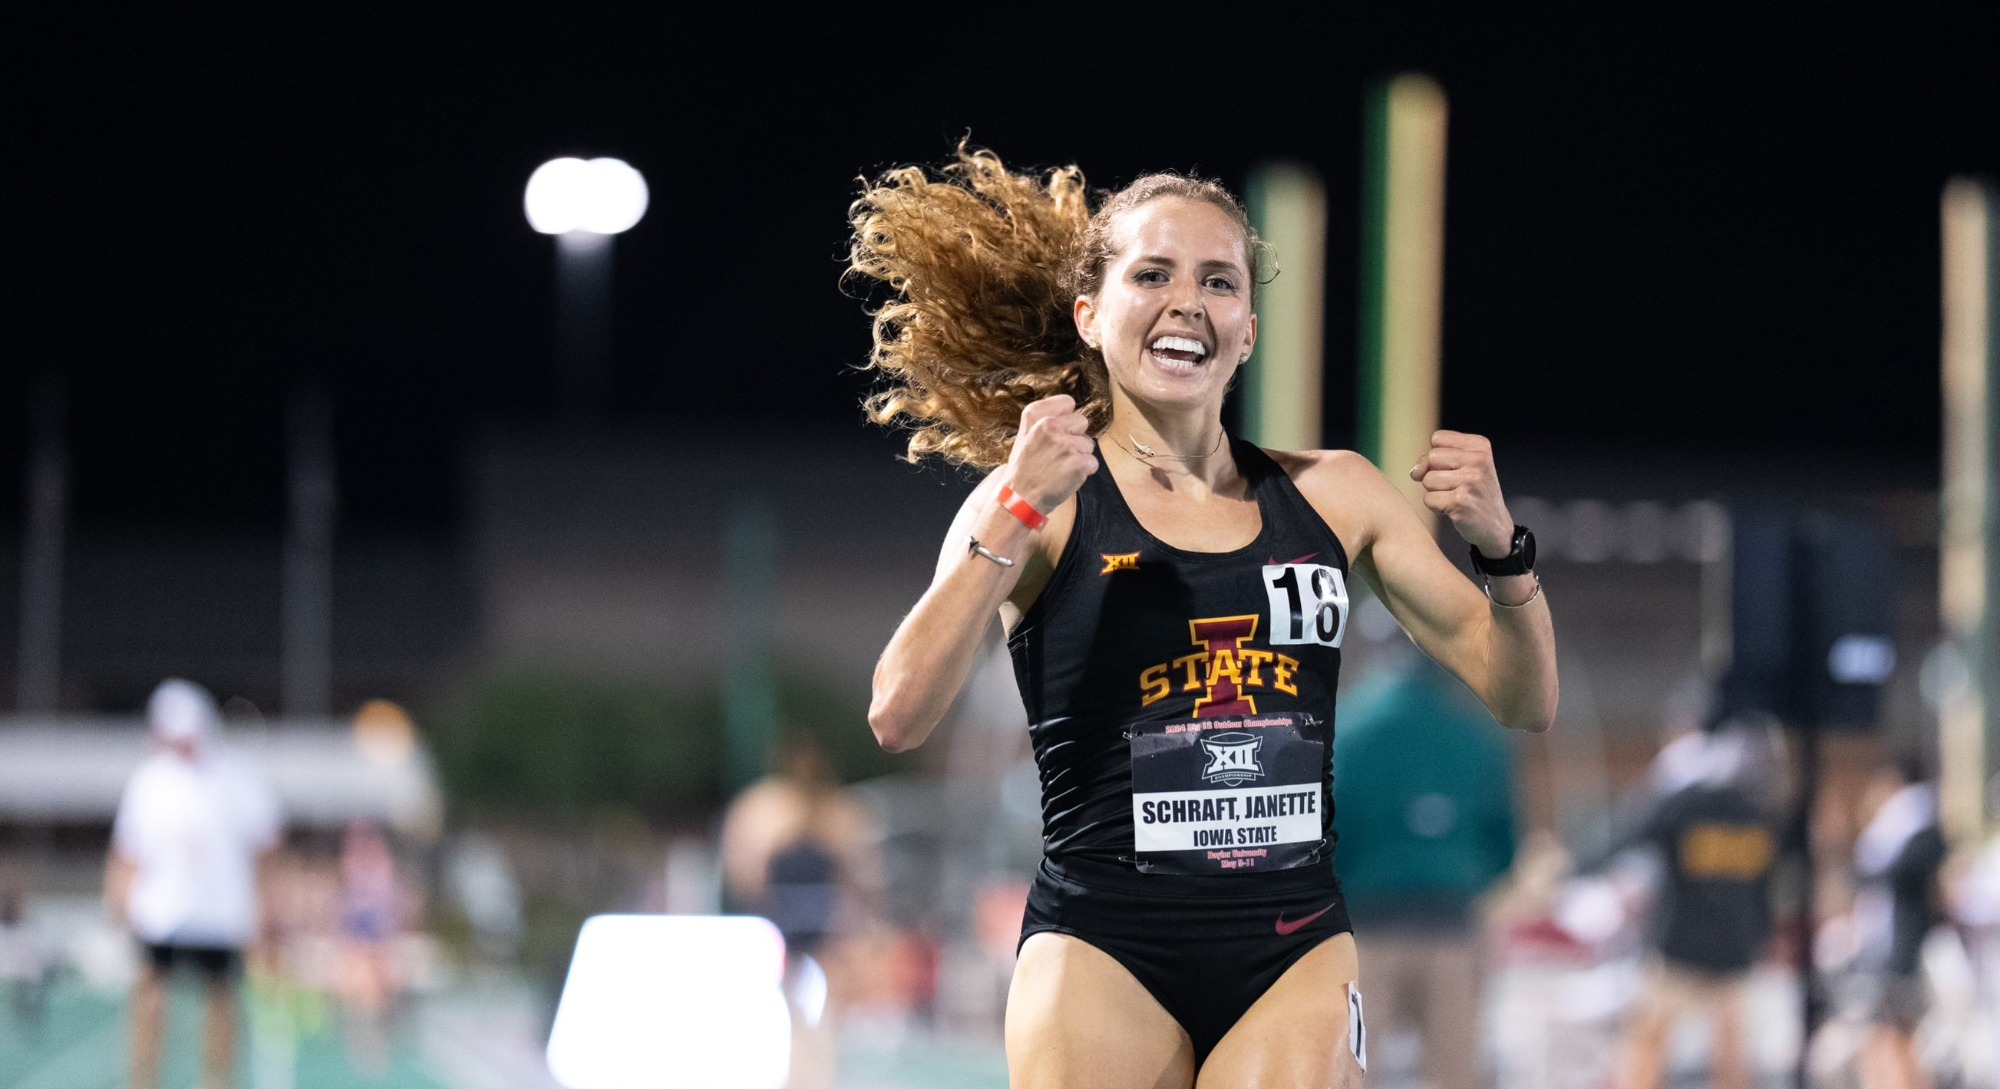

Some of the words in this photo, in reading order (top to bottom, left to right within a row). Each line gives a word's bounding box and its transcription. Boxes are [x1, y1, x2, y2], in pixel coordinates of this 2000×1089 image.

[1100, 551, 1142, 576] XII
[1140, 649, 1299, 707] STATE
[1165, 724, 1186, 734] 2024
[1187, 723, 1201, 733] Big
[1202, 721, 1212, 730] 12
[1213, 719, 1242, 729] Outdoor
[1243, 717, 1293, 729] Championships
[1206, 740, 1260, 774] XII
[1142, 797, 1240, 824] SCHRAFT,
[1244, 791, 1316, 819] JANETTE
[1193, 829, 1235, 847] IOWA
[1237, 826, 1277, 844] STATE
[1207, 850, 1231, 860] Baylor
[1231, 848, 1267, 858] University
[1221, 860, 1237, 869] May
